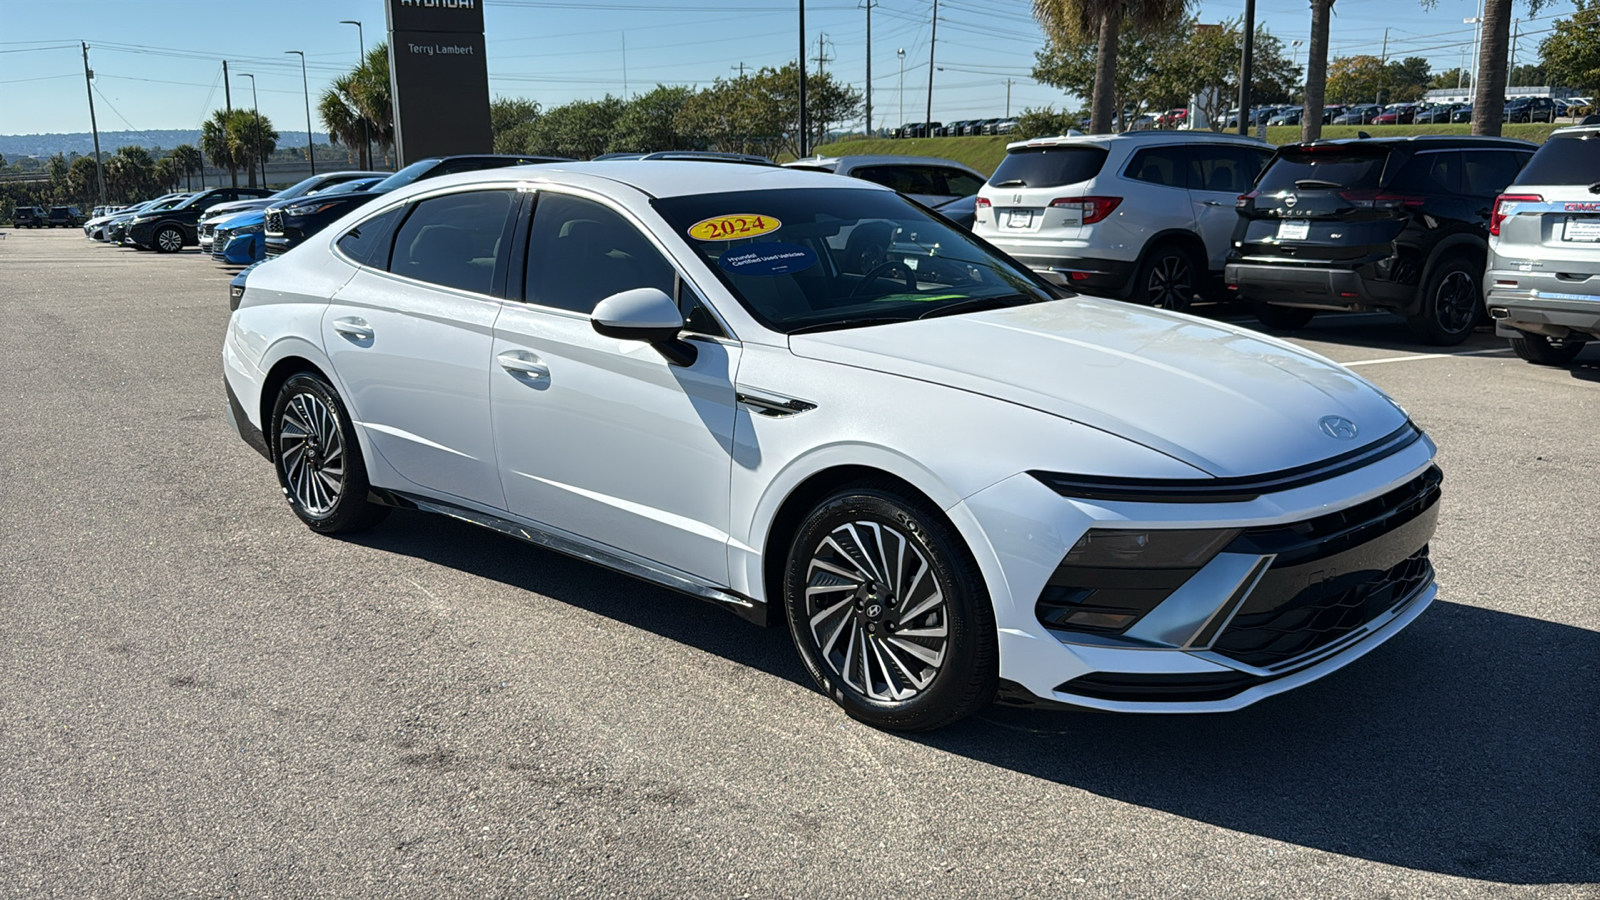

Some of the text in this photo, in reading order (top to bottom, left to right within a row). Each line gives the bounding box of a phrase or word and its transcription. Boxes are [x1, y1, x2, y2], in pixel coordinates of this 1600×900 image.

[408, 43, 474, 56] Terry Lambert
[1269, 209, 1313, 217] ROGUE
[1564, 202, 1600, 212] GMC
[705, 216, 765, 239] 2024
[727, 252, 758, 263] Hyundai
[732, 251, 805, 267] Certified Used Vehicles
